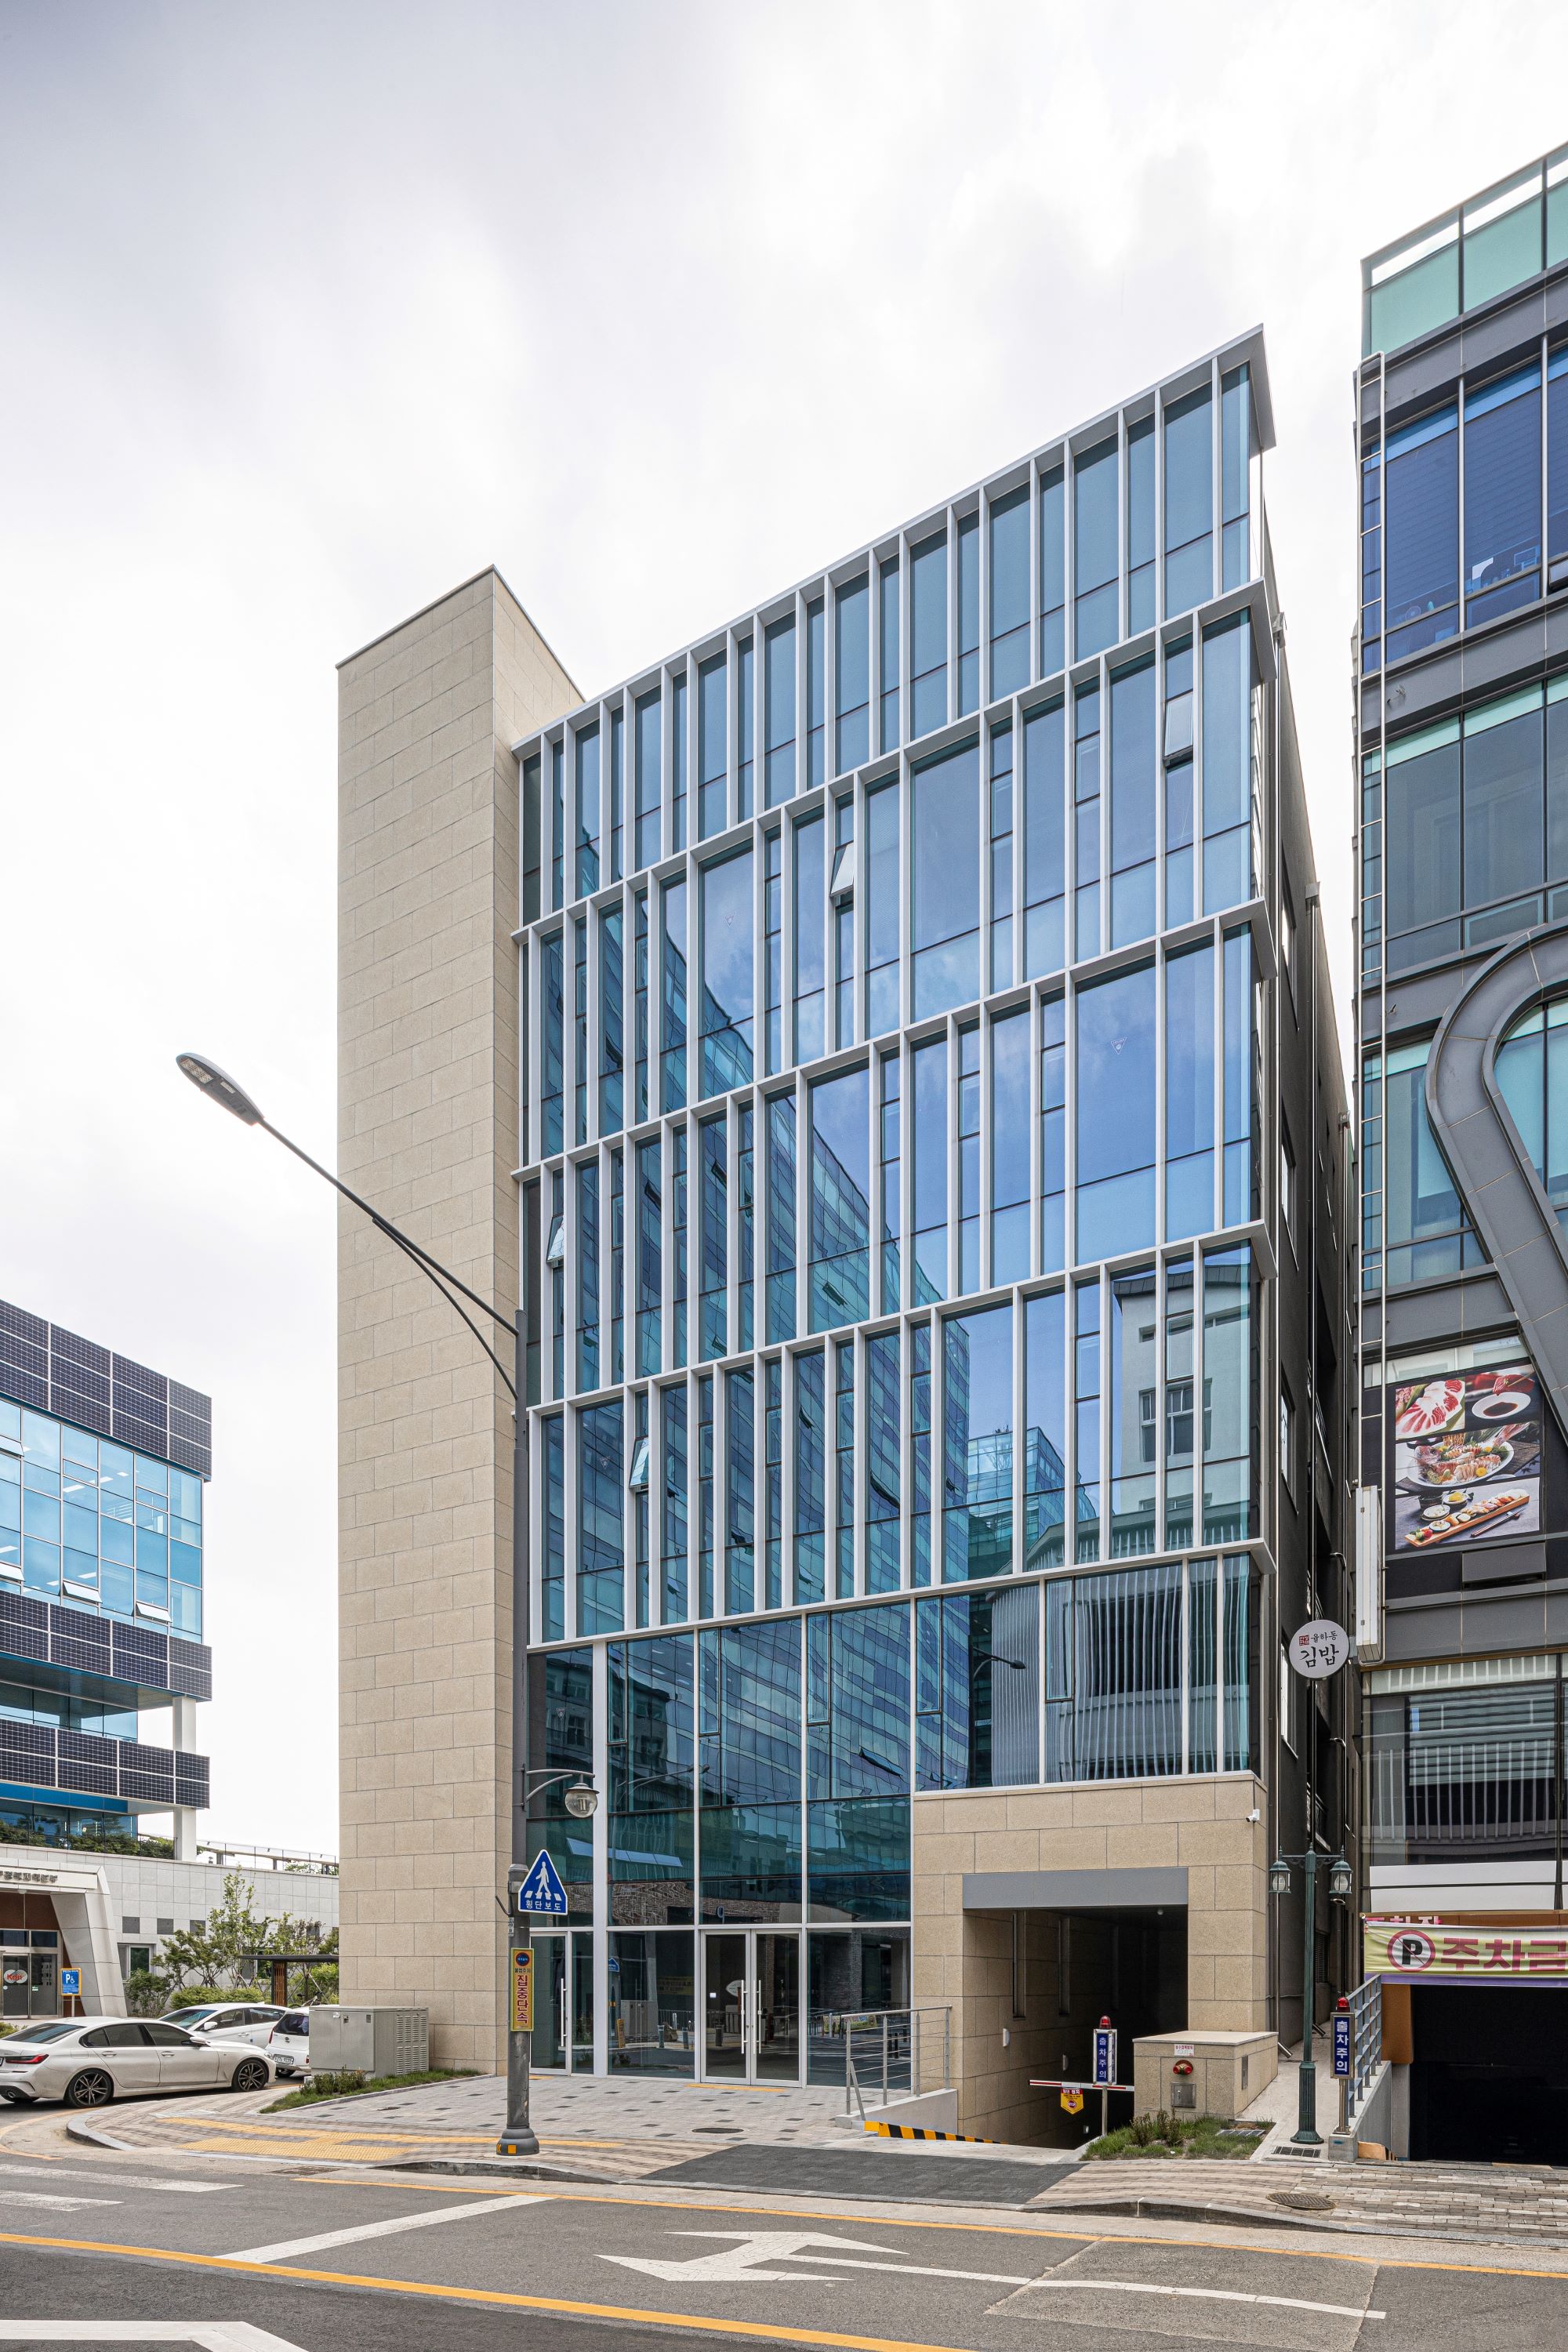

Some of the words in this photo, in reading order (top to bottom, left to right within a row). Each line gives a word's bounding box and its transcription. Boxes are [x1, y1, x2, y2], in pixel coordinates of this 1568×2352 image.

[1299, 1644, 1339, 1668] 김밥
[525, 1900, 561, 1911] 횡단보도
[1440, 1937, 1568, 1972] 주차금
[66, 1973, 71, 1984] P
[517, 1975, 528, 2024] 집중단속
[1098, 2037, 1107, 2079] 출차주의
[1336, 2020, 1348, 2072] 출차주의
